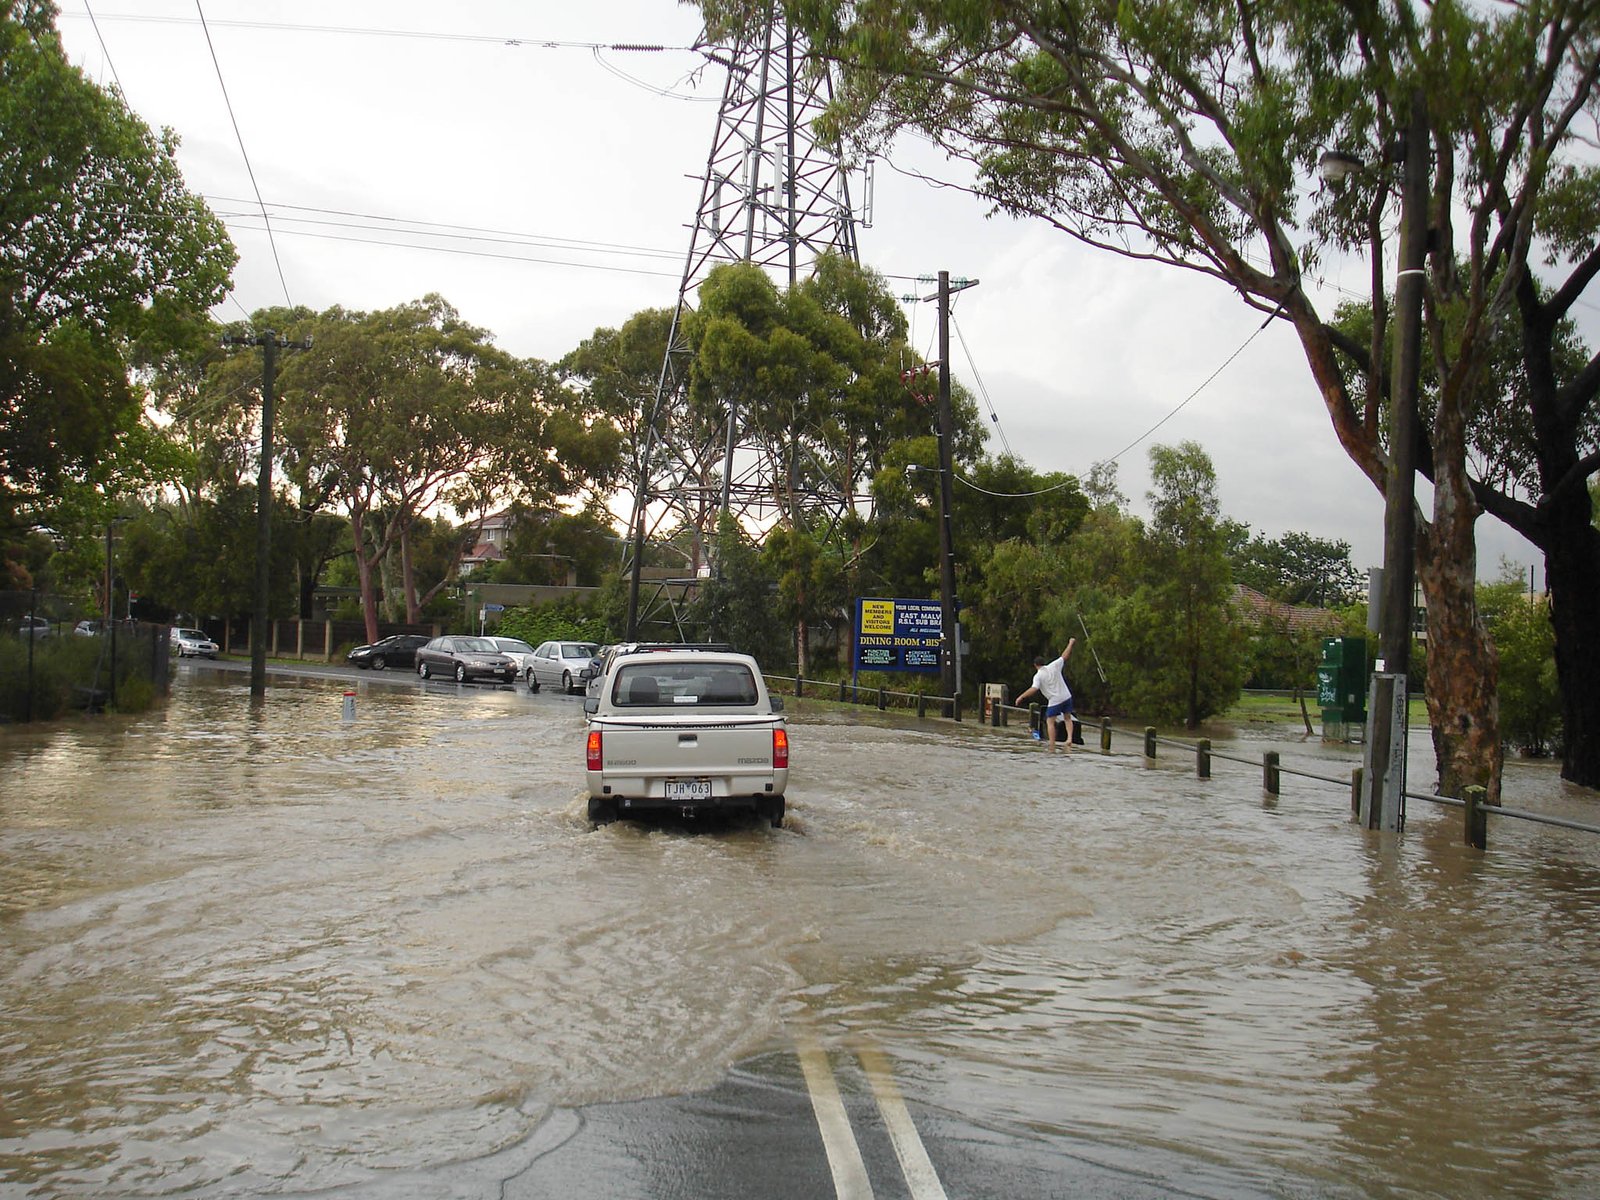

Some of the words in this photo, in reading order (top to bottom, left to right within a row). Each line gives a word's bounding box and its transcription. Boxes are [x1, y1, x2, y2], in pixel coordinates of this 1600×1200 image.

[860, 637, 891, 645] DINING
[894, 638, 920, 646] ROOM
[926, 638, 941, 646] BIS
[667, 783, 685, 794] TJH
[691, 783, 710, 794] 063
